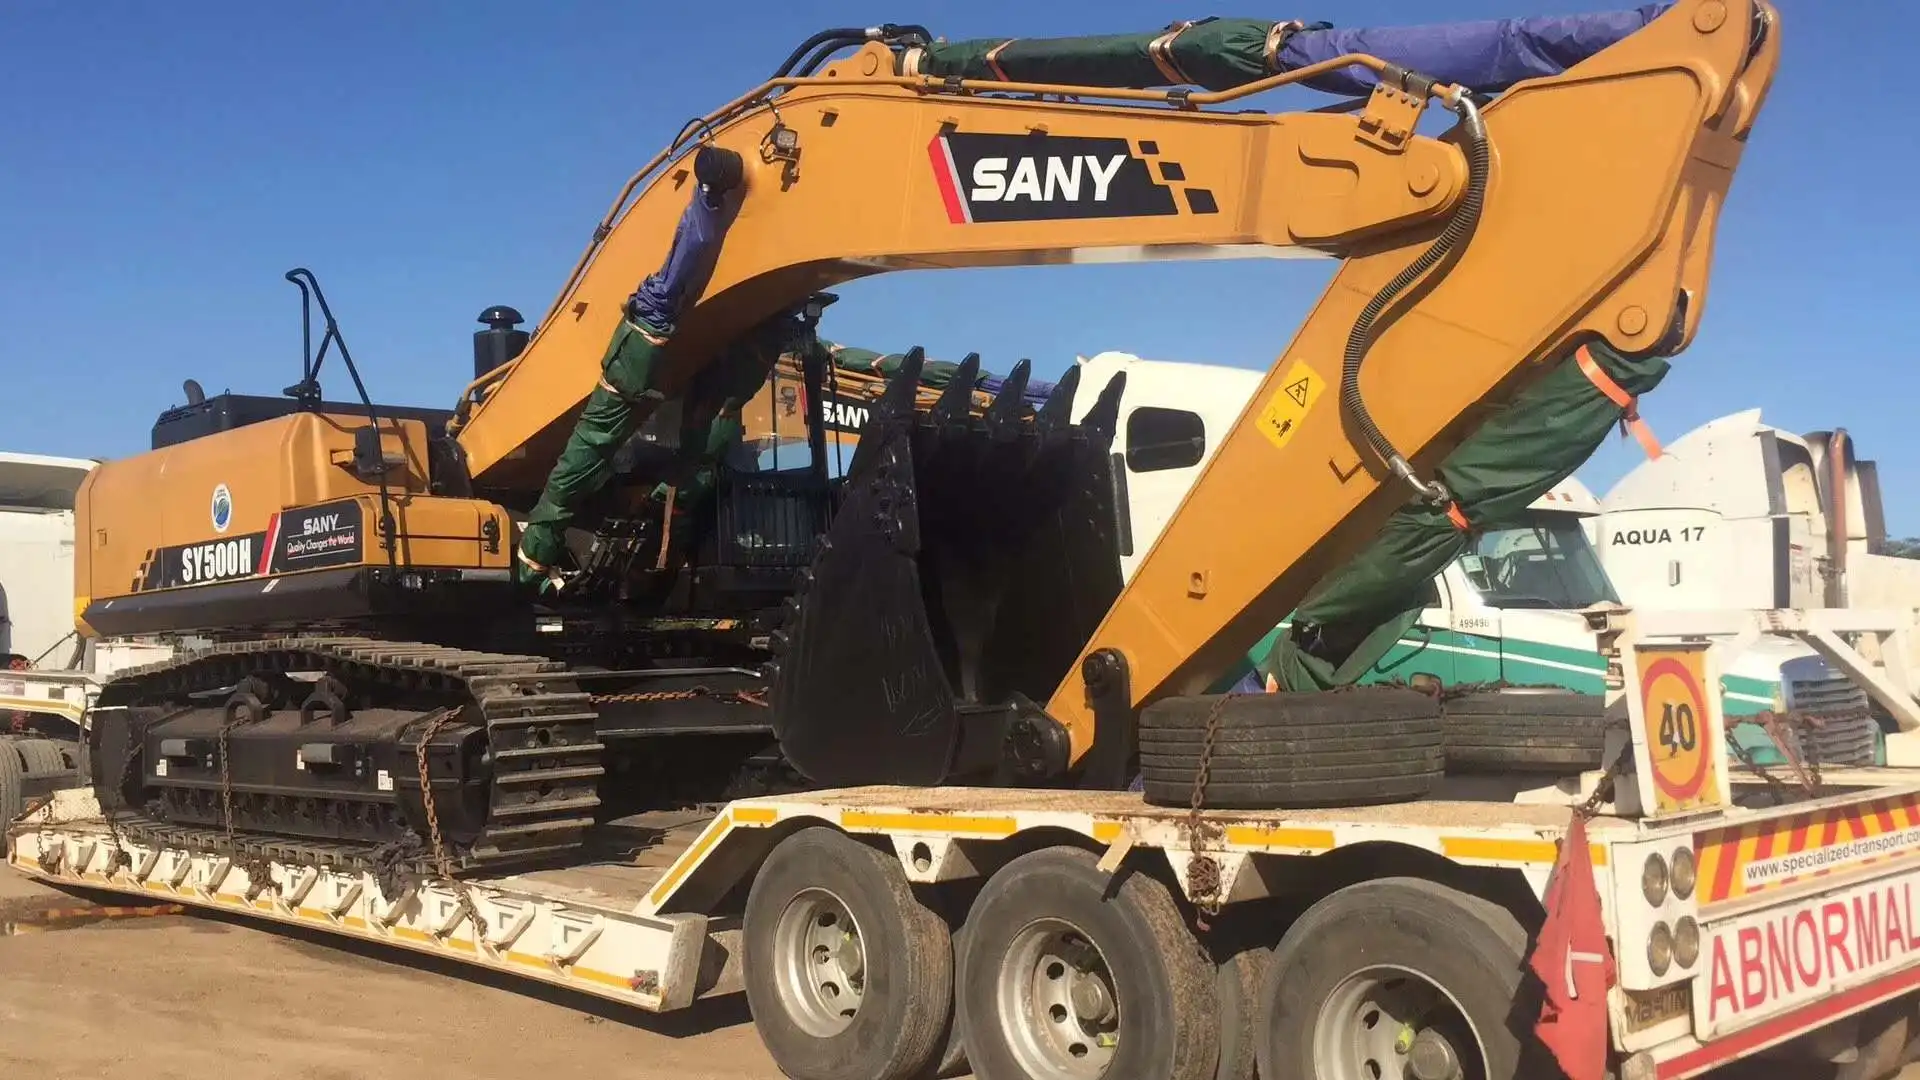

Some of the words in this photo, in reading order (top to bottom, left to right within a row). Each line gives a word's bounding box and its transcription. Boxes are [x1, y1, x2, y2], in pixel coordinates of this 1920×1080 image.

[971, 154, 1127, 202] SANY
[287, 539, 306, 555] Quality
[306, 538, 328, 551] Changes
[328, 534, 337, 547] the
[337, 531, 355, 545] World
[303, 513, 339, 536] SANY
[1612, 528, 1672, 546] AQUA
[1680, 526, 1705, 542] 17
[182, 538, 251, 582] SY500H
[1659, 702, 1696, 757] 40
[1746, 829, 1920, 880] www.specialized-transport.co
[1709, 883, 1920, 1023] ABNORMAL
